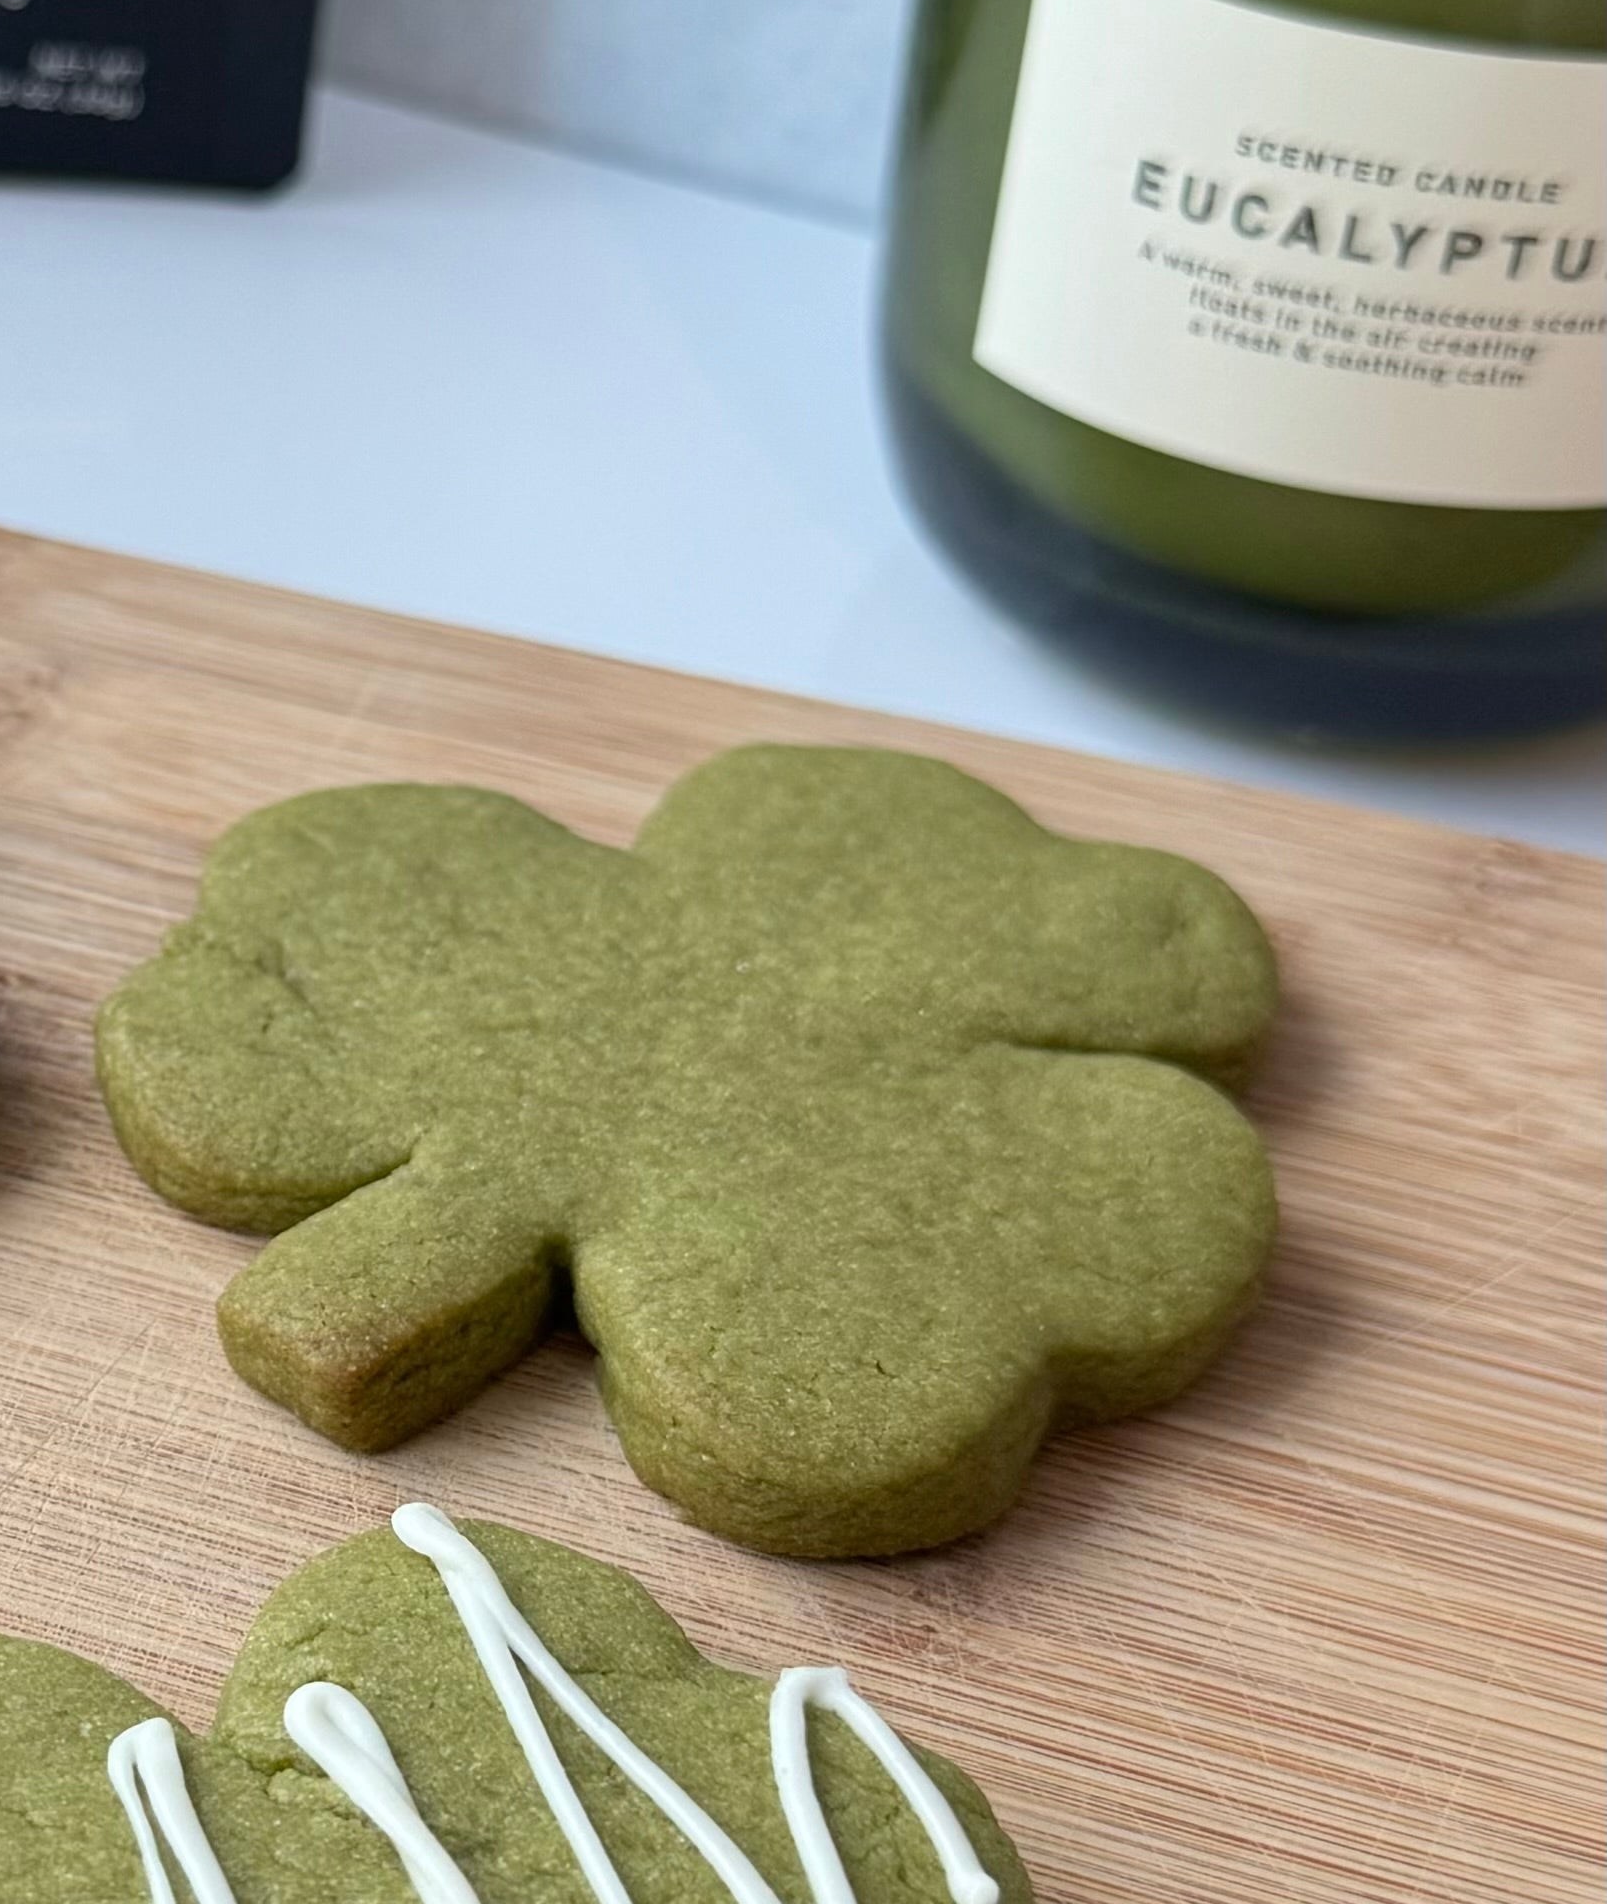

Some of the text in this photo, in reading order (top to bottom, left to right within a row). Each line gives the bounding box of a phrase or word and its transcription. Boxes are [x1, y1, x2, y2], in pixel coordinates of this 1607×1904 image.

[1235, 132, 1564, 206] SCENTED CANDLE
[1129, 155, 1607, 284] EUCALYPTU
[1162, 249, 1243, 292] warm,
[1251, 276, 1341, 315] sweet,
[1353, 295, 1522, 332] herbaceous
[1188, 283, 1538, 366] floats in the air creating
[1187, 316, 1528, 388] a fresh & soothing calm
